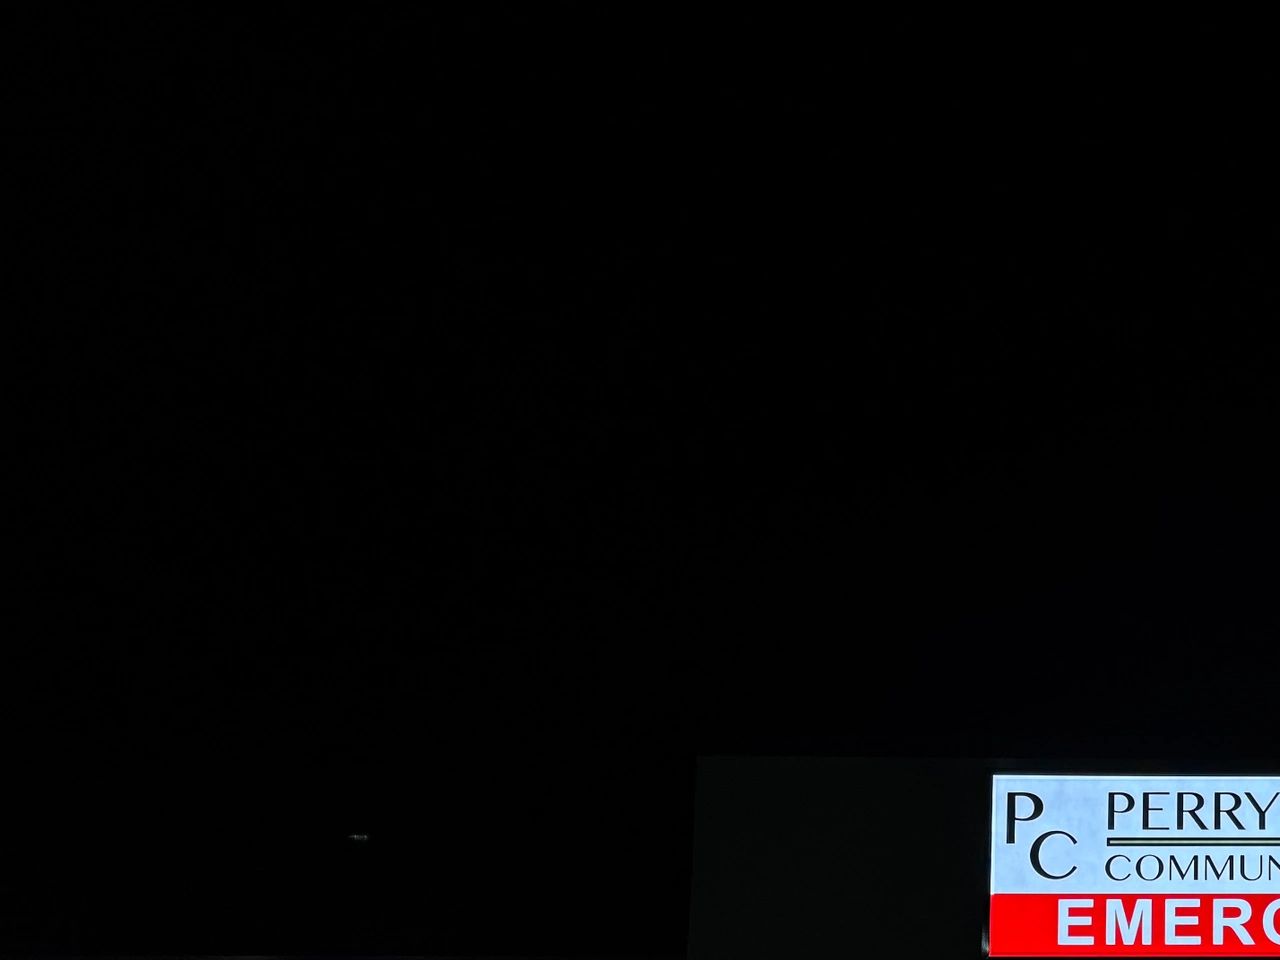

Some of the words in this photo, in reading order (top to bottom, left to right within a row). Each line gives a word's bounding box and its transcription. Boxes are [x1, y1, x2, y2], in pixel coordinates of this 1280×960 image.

[1006, 792, 1045, 845] P
[1107, 791, 1280, 831] PERRY
[1029, 831, 1078, 880] C
